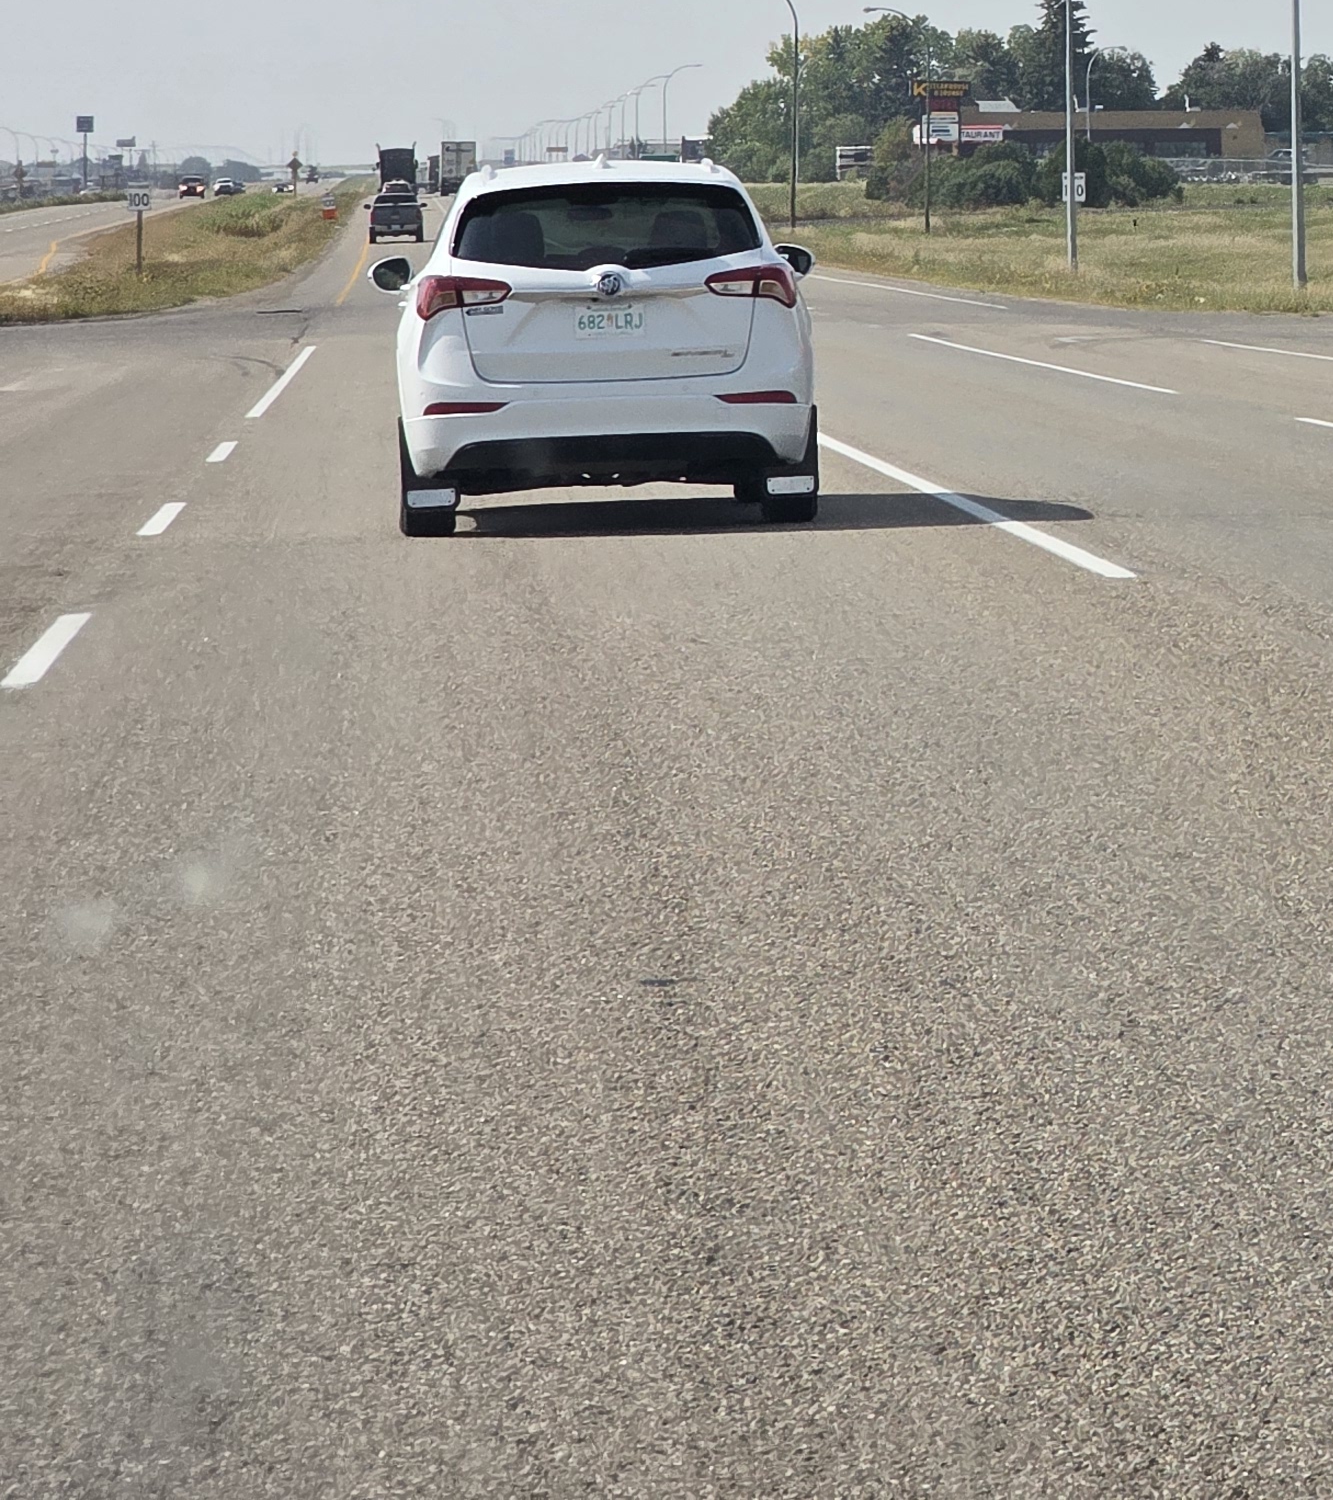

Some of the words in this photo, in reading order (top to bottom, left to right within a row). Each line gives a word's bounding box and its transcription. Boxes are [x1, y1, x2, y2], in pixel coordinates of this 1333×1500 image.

[961, 131, 1001, 139] TAURANT
[1064, 184, 1084, 197] 10
[129, 192, 150, 207] 100
[578, 314, 605, 330] 682
[615, 312, 643, 330] LRJ
